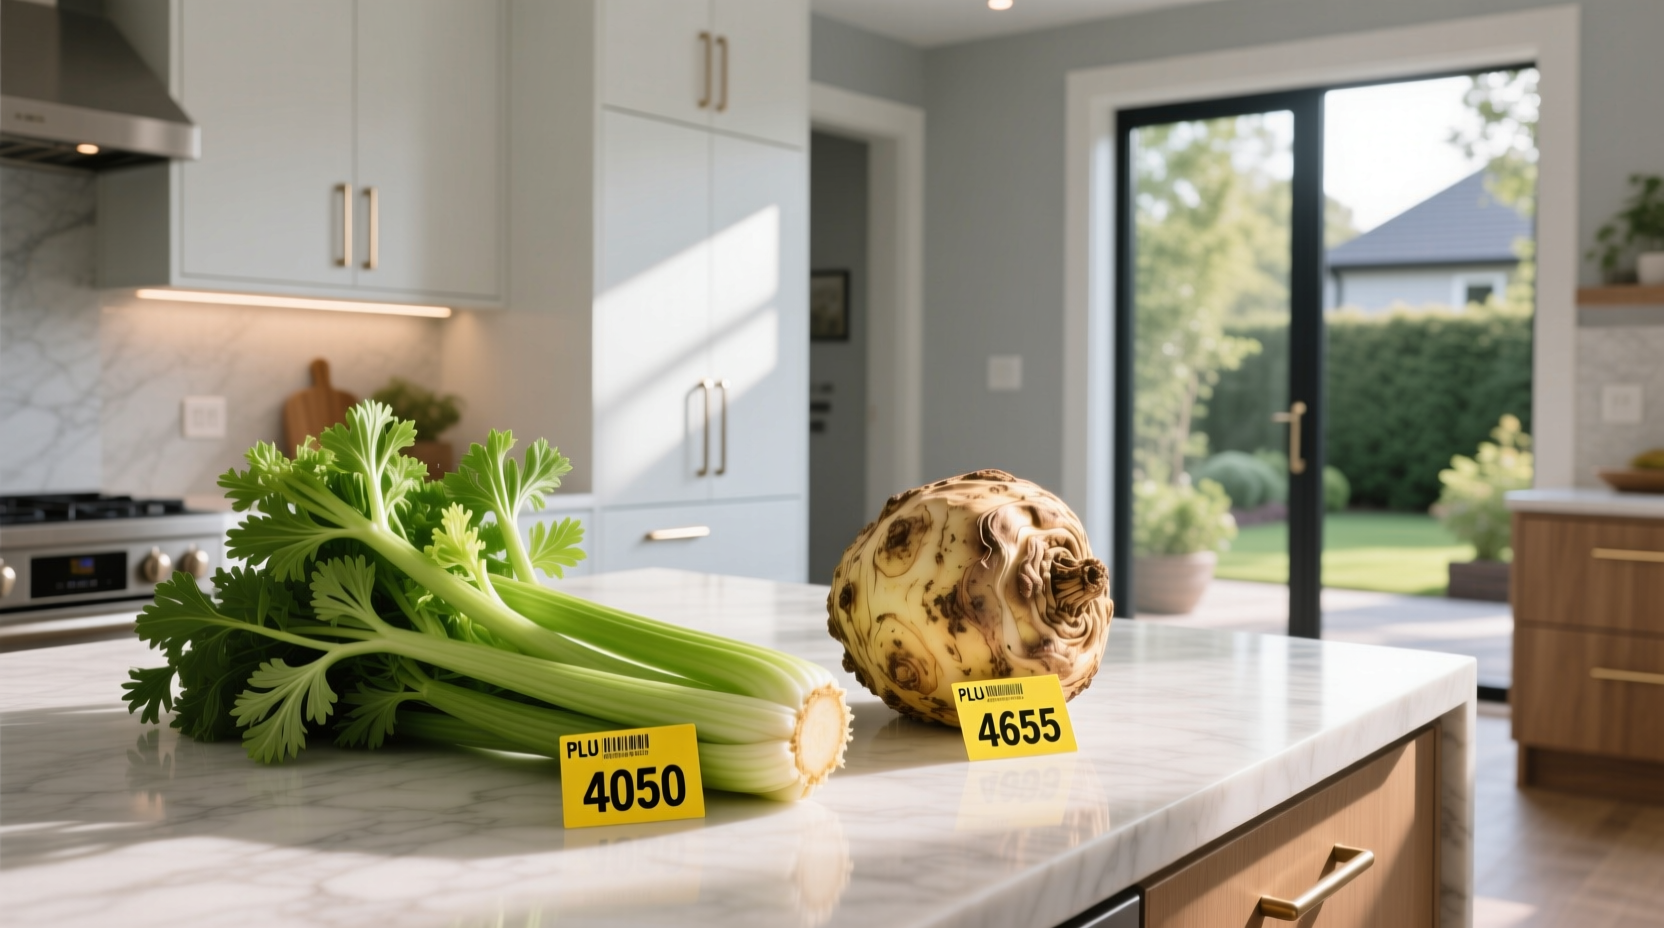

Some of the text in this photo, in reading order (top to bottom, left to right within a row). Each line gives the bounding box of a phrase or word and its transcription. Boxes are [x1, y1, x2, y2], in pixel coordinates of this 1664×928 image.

[958, 686, 985, 702] PLU
[978, 707, 1061, 747] 4655
[566, 739, 599, 759] PLU
[583, 764, 686, 812] 4050
